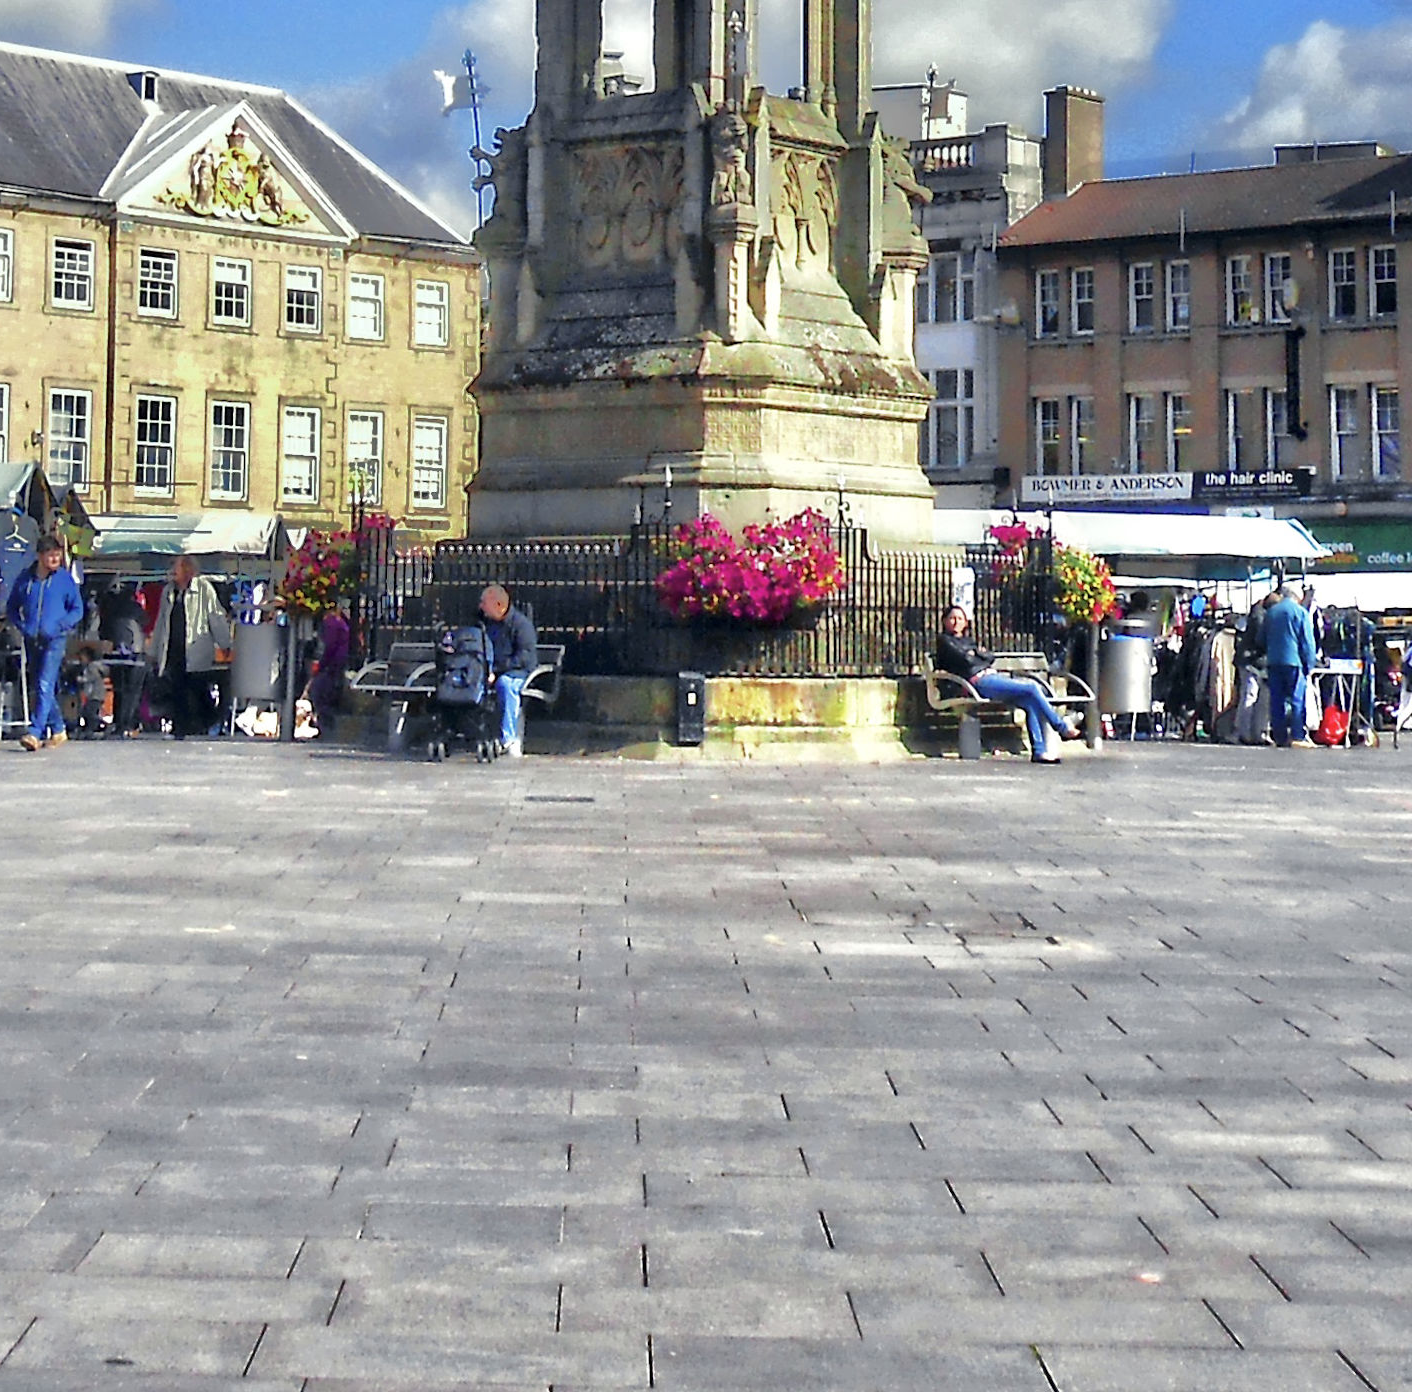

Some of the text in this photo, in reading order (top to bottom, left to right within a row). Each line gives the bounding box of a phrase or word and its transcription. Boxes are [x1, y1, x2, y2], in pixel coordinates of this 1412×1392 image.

[1032, 479, 1091, 492] BOWMER
[1110, 476, 1184, 490] ANDERSON
[1205, 470, 1294, 485] the hair clinic
[1367, 551, 1404, 564] coffee
